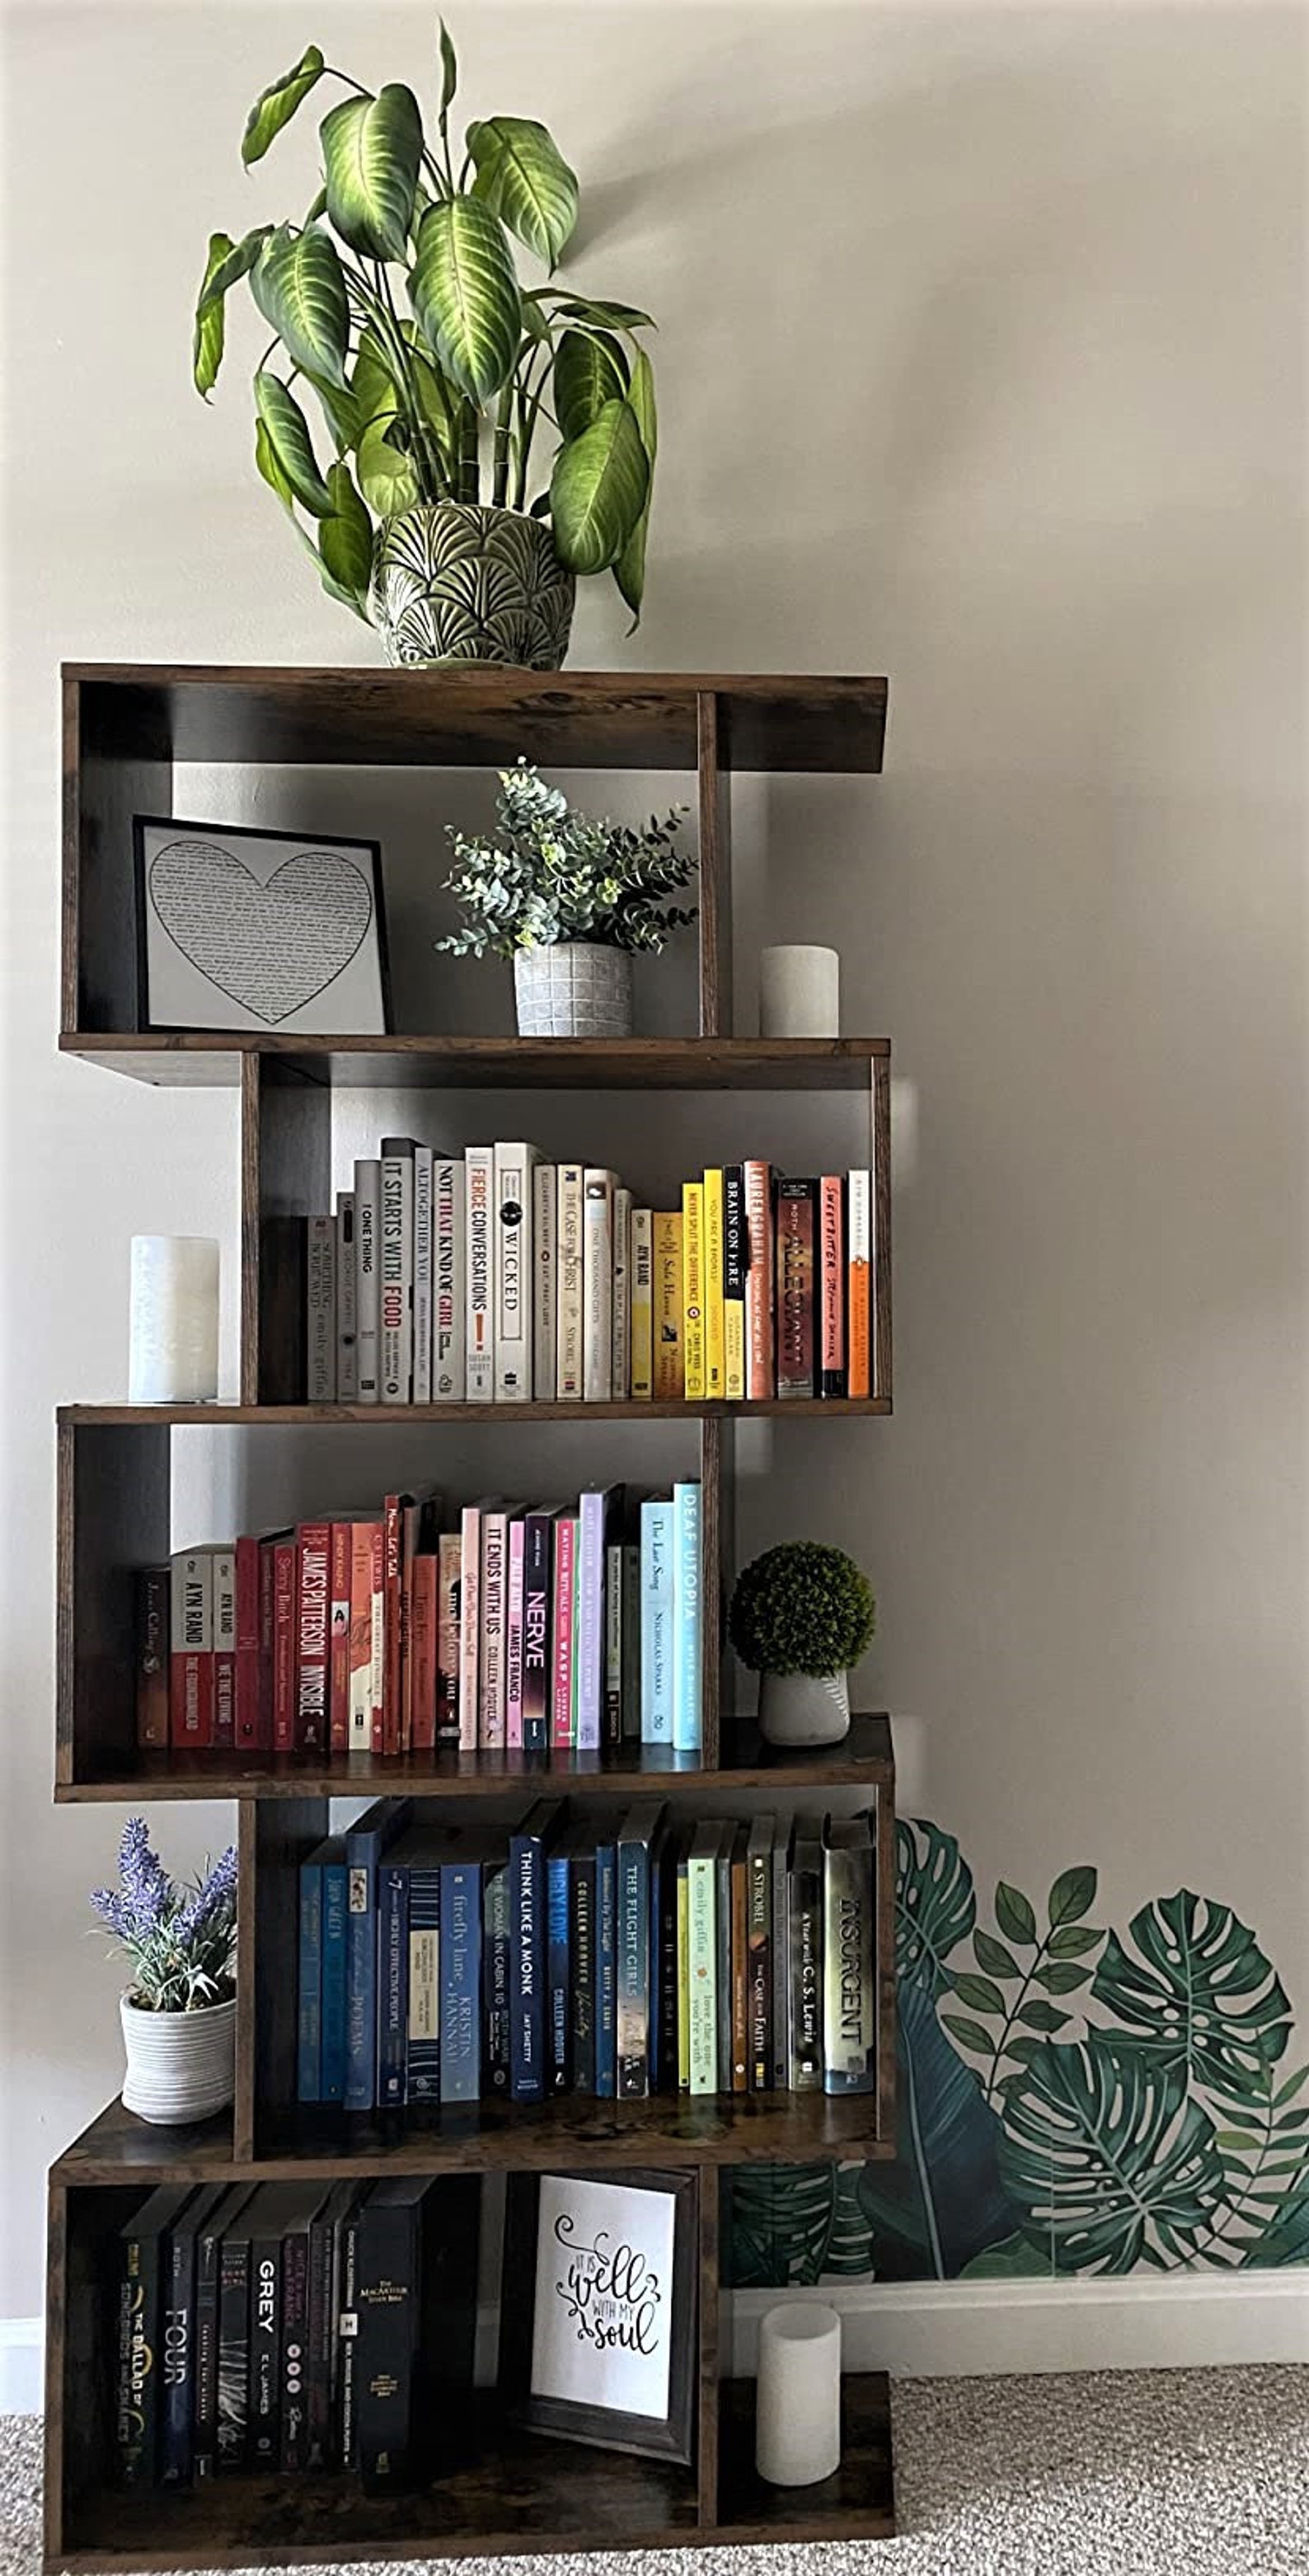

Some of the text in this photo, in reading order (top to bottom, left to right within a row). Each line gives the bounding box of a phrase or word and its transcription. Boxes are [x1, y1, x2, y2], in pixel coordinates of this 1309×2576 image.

[384, 1162, 401, 1176] IT
[439, 1165, 453, 1194] NOT
[471, 1169, 487, 1210] FIERCE
[384, 1180, 402, 1236] STARTS
[710, 1199, 718, 1217] YOU
[749, 1167, 763, 1215] LAUREN
[362, 1210, 373, 1235] ONE
[417, 1164, 429, 1283] ALTOGETHER YOU
[439, 1197, 453, 1233] THAT
[565, 1211, 576, 1235] CASE
[710, 1220, 718, 1235] ARE
[727, 1181, 739, 1286] BRAIN ON FIRE
[826, 1187, 837, 1268] SWEETBITTER
[362, 1238, 373, 1273] THING
[384, 1240, 402, 1281] WITH
[439, 1235, 453, 1272] KIND
[471, 1211, 487, 1311] CONVERSATIONS
[637, 1245, 649, 1286] AYN RAND
[688, 1192, 698, 1302] NEVER SPLIT THE DIFFERENCE
[439, 1274, 453, 1293] OF
[504, 1232, 518, 1311] WICKED
[565, 1254, 579, 1291] CHRIST
[384, 1286, 402, 1328] FOOD
[439, 1295, 453, 1328] GIRL
[784, 1233, 805, 1365] ALLEGIANT
[302, 1548, 327, 1589] JAMES
[561, 1528, 570, 1568] MATING
[649, 1520, 664, 1591] The Last Song
[683, 1494, 696, 1620] DEAF UTOPIA
[373, 1553, 382, 1586] LEWIS
[486, 1528, 502, 1635] IT ENDS WITH US
[278, 1595, 290, 1623] Bitch
[448, 1591, 457, 1616] me
[560, 1571, 569, 1613] RITUALS
[185, 1582, 203, 1644] AYN RAND
[220, 1593, 232, 1634] AYN RAND
[300, 1590, 326, 1656] PATTERSON
[527, 1591, 546, 1668] NERVE
[185, 1656, 199, 1672] THE
[510, 1623, 520, 1703] JAMES FRANCO
[560, 1641, 568, 1681] WASP
[654, 1612, 664, 1695] NICHOLAS SPARKS
[218, 1664, 232, 1724] WE THE LIVING
[299, 1665, 325, 1717] INVISIBLE
[442, 1671, 457, 1700] you
[487, 1646, 499, 1720] COLLEEN HOOVER
[387, 1881, 403, 1890] 7
[494, 1875, 504, 1894] THE
[753, 1873, 766, 1923] STROBEL
[493, 1896, 504, 1939] WOMAN
[520, 1851, 533, 1995] THINK LIKE A MONK
[549, 1867, 567, 1946] UGLY LOVE
[695, 1880, 706, 1953] emily giffin
[802, 1912, 810, 1920] A
[389, 1913, 400, 1946] HIGHLY
[449, 1895, 468, 1981] firefly lane
[494, 1942, 504, 1953] IN
[577, 1880, 589, 1984] COLLEEN HOOVER
[626, 1866, 638, 1997] THE FLIGHT GIRLS
[802, 1921, 811, 1941] Year
[389, 1947, 400, 1994] EFFECTIVE
[494, 1955, 504, 1988] CABIN
[802, 1965, 814, 1983] C.
[840, 1898, 861, 2045] INSURGENT
[389, 1995, 400, 2030] PEOPLE
[494, 1993, 504, 2005] 10
[703, 1994, 713, 2019] love
[802, 1986, 814, 2000] S.
[445, 1993, 458, 2063] HANNAH
[459, 1997, 472, 2057] KRISTIN
[553, 1988, 565, 2064] COLLEEN HOOVER
[703, 2022, 713, 2040] the
[754, 1978, 766, 2052] CASE FAITH
[802, 2003, 815, 2043] Lewis
[523, 2014, 532, 2063] JAY SHETTY
[693, 2038, 702, 2063] with
[172, 2246, 181, 2278] ROTH
[568, 2245, 648, 2307] well
[586, 2255, 596, 2273] IS
[259, 2260, 274, 2333] GREY
[592, 2299, 635, 2321] WITH MY
[119, 2282, 131, 2360] SONGBIRDS
[594, 2301, 659, 2355] soul
[132, 2312, 144, 2407] THE BALLAD OF
[163, 2308, 187, 2385] FOUR
[260, 2374, 269, 2414] JAMES
